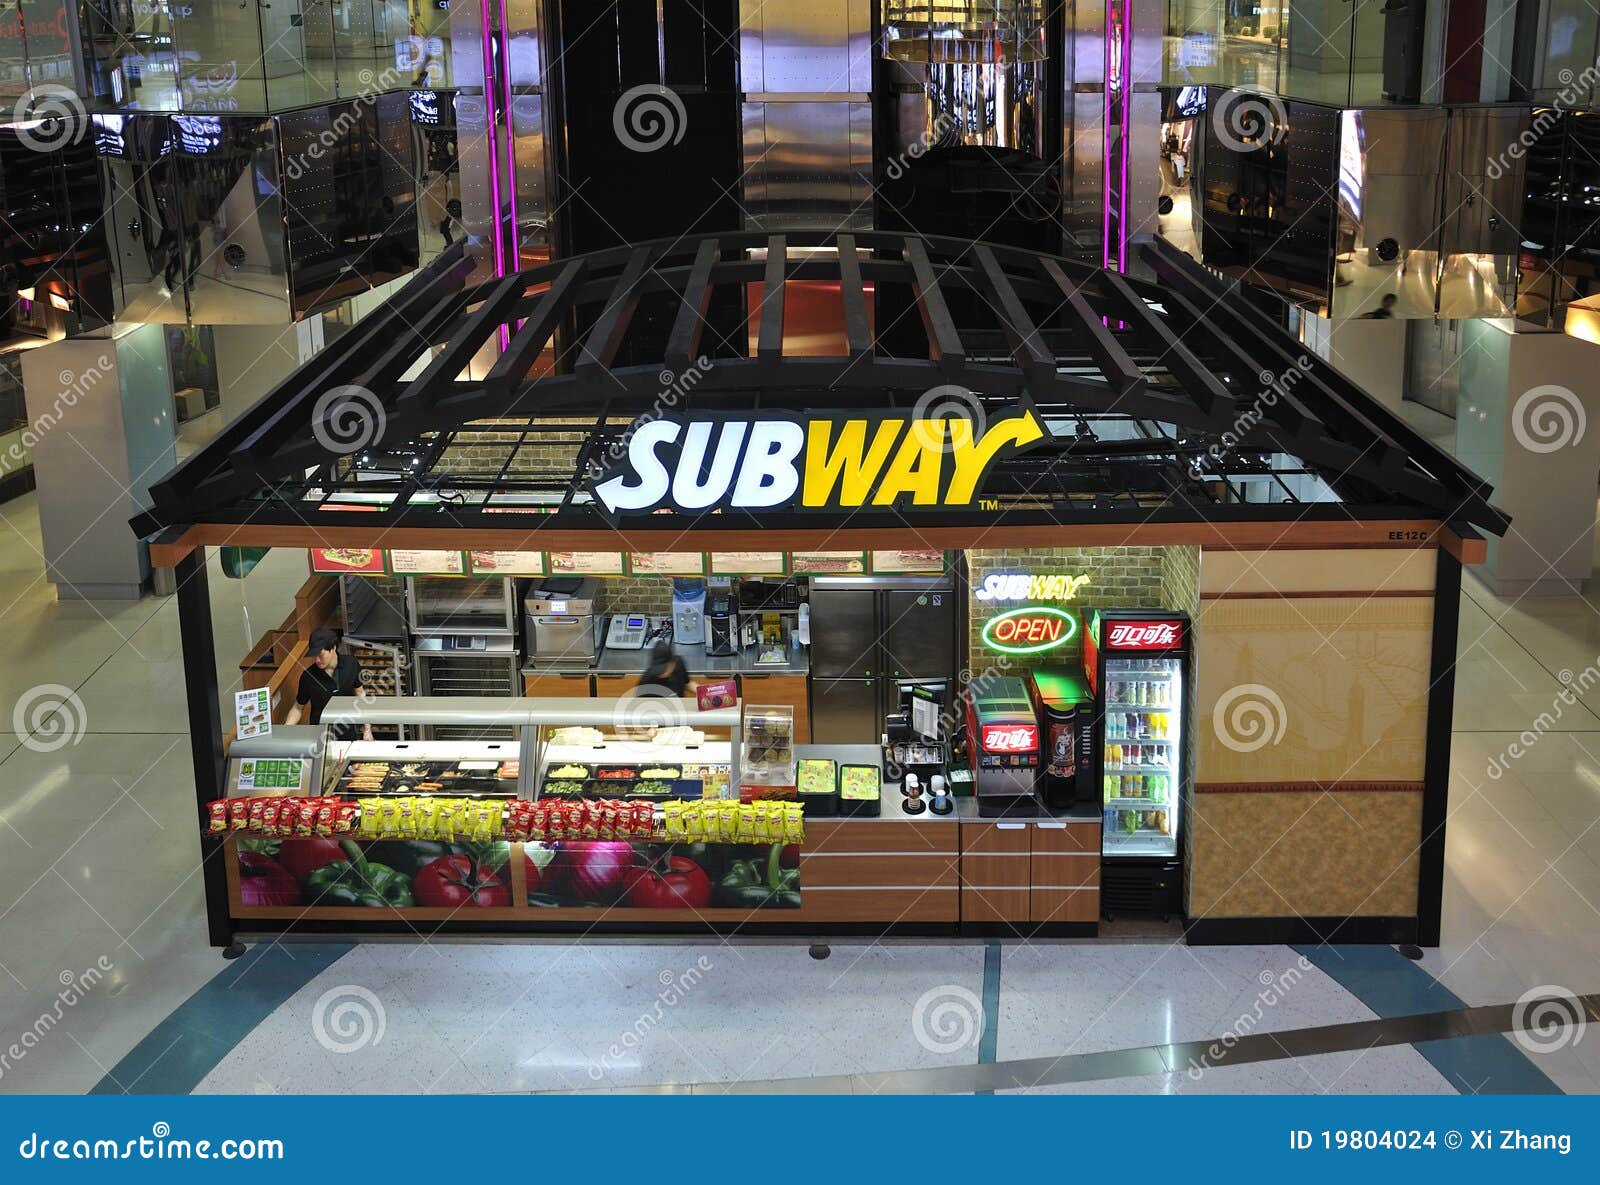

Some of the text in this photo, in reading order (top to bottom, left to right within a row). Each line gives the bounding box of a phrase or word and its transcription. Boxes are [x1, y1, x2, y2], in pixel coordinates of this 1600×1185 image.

[596, 409, 1044, 514] SUBWAY
[1388, 531, 1428, 540] EE12C
[976, 574, 1091, 601] SUBWAY
[995, 618, 1062, 641] OPEN
[1109, 623, 1181, 647] 可口可乐
[985, 728, 1035, 750] 可口可乐
